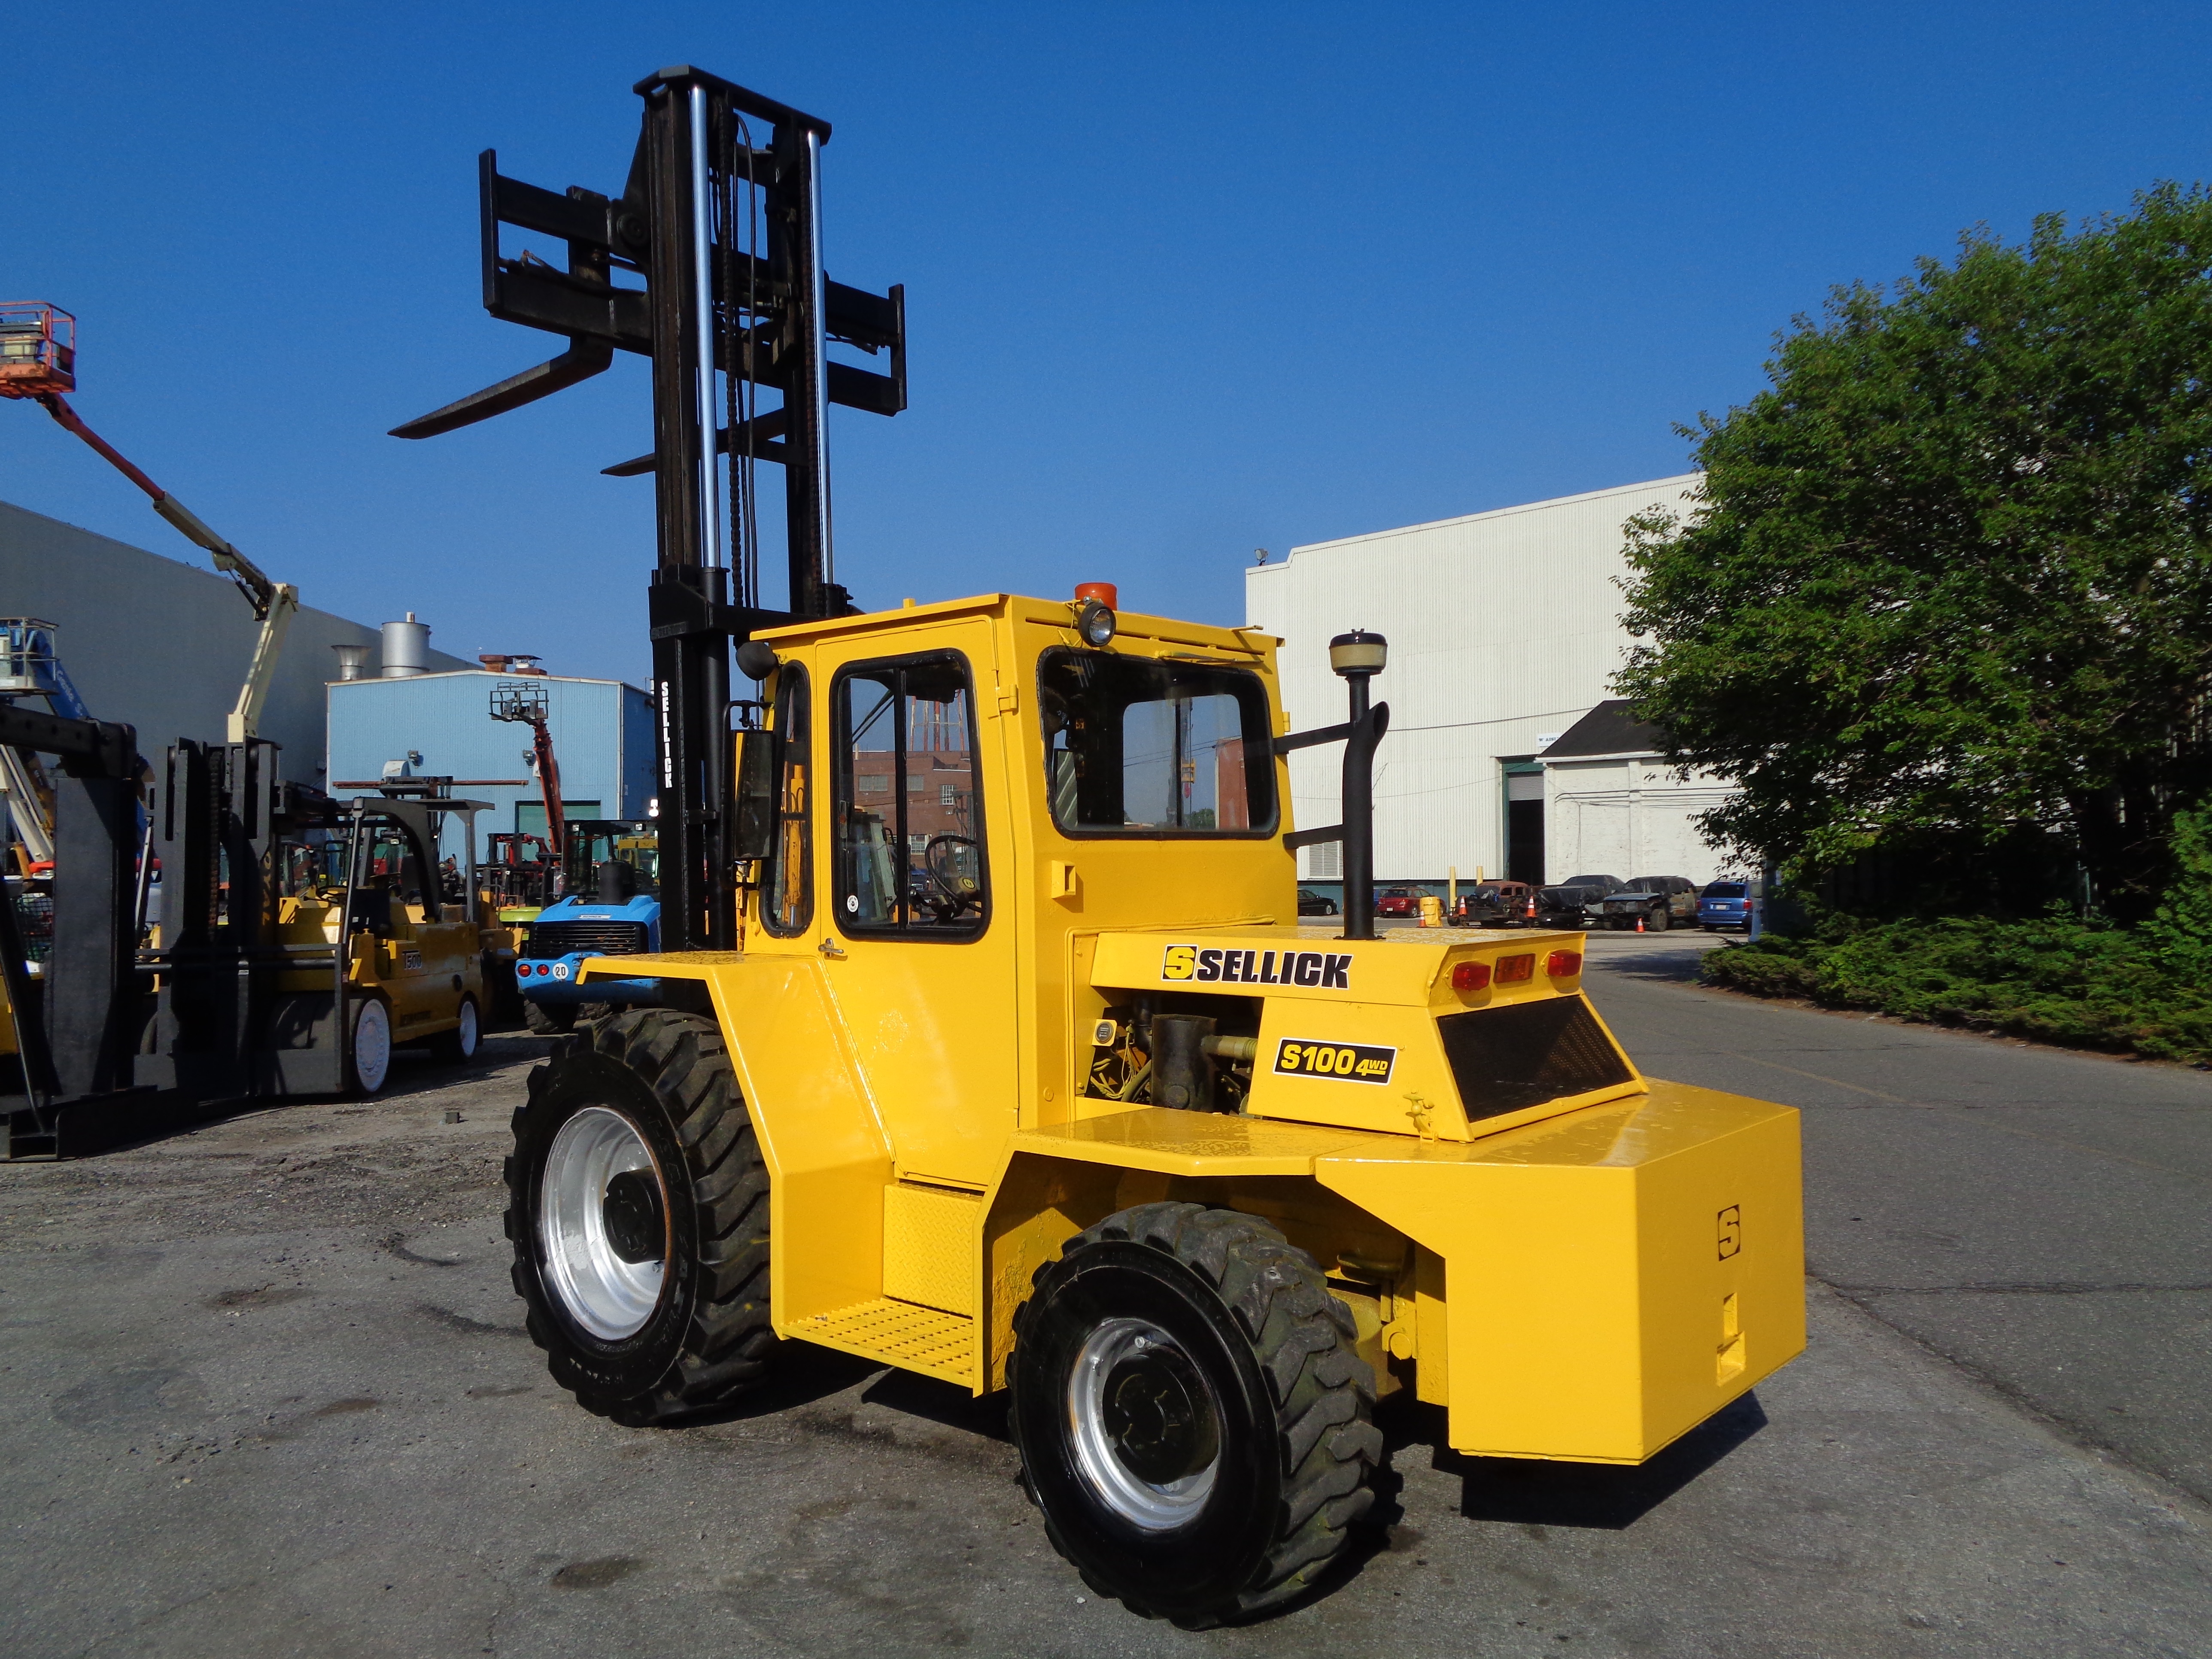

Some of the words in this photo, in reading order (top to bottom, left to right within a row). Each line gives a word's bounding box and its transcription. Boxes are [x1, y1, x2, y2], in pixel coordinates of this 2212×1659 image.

[660, 681, 673, 789] SELLICK
[261, 851, 272, 926] OYAL
[402, 949, 422, 970] T500
[555, 966, 566, 976] 20
[1164, 946, 1197, 980] S
[1196, 949, 1353, 990] SELLICK
[1280, 1044, 1356, 1075] S100
[1355, 1059, 1388, 1076] 4WD
[1718, 1204, 1741, 1261] S
